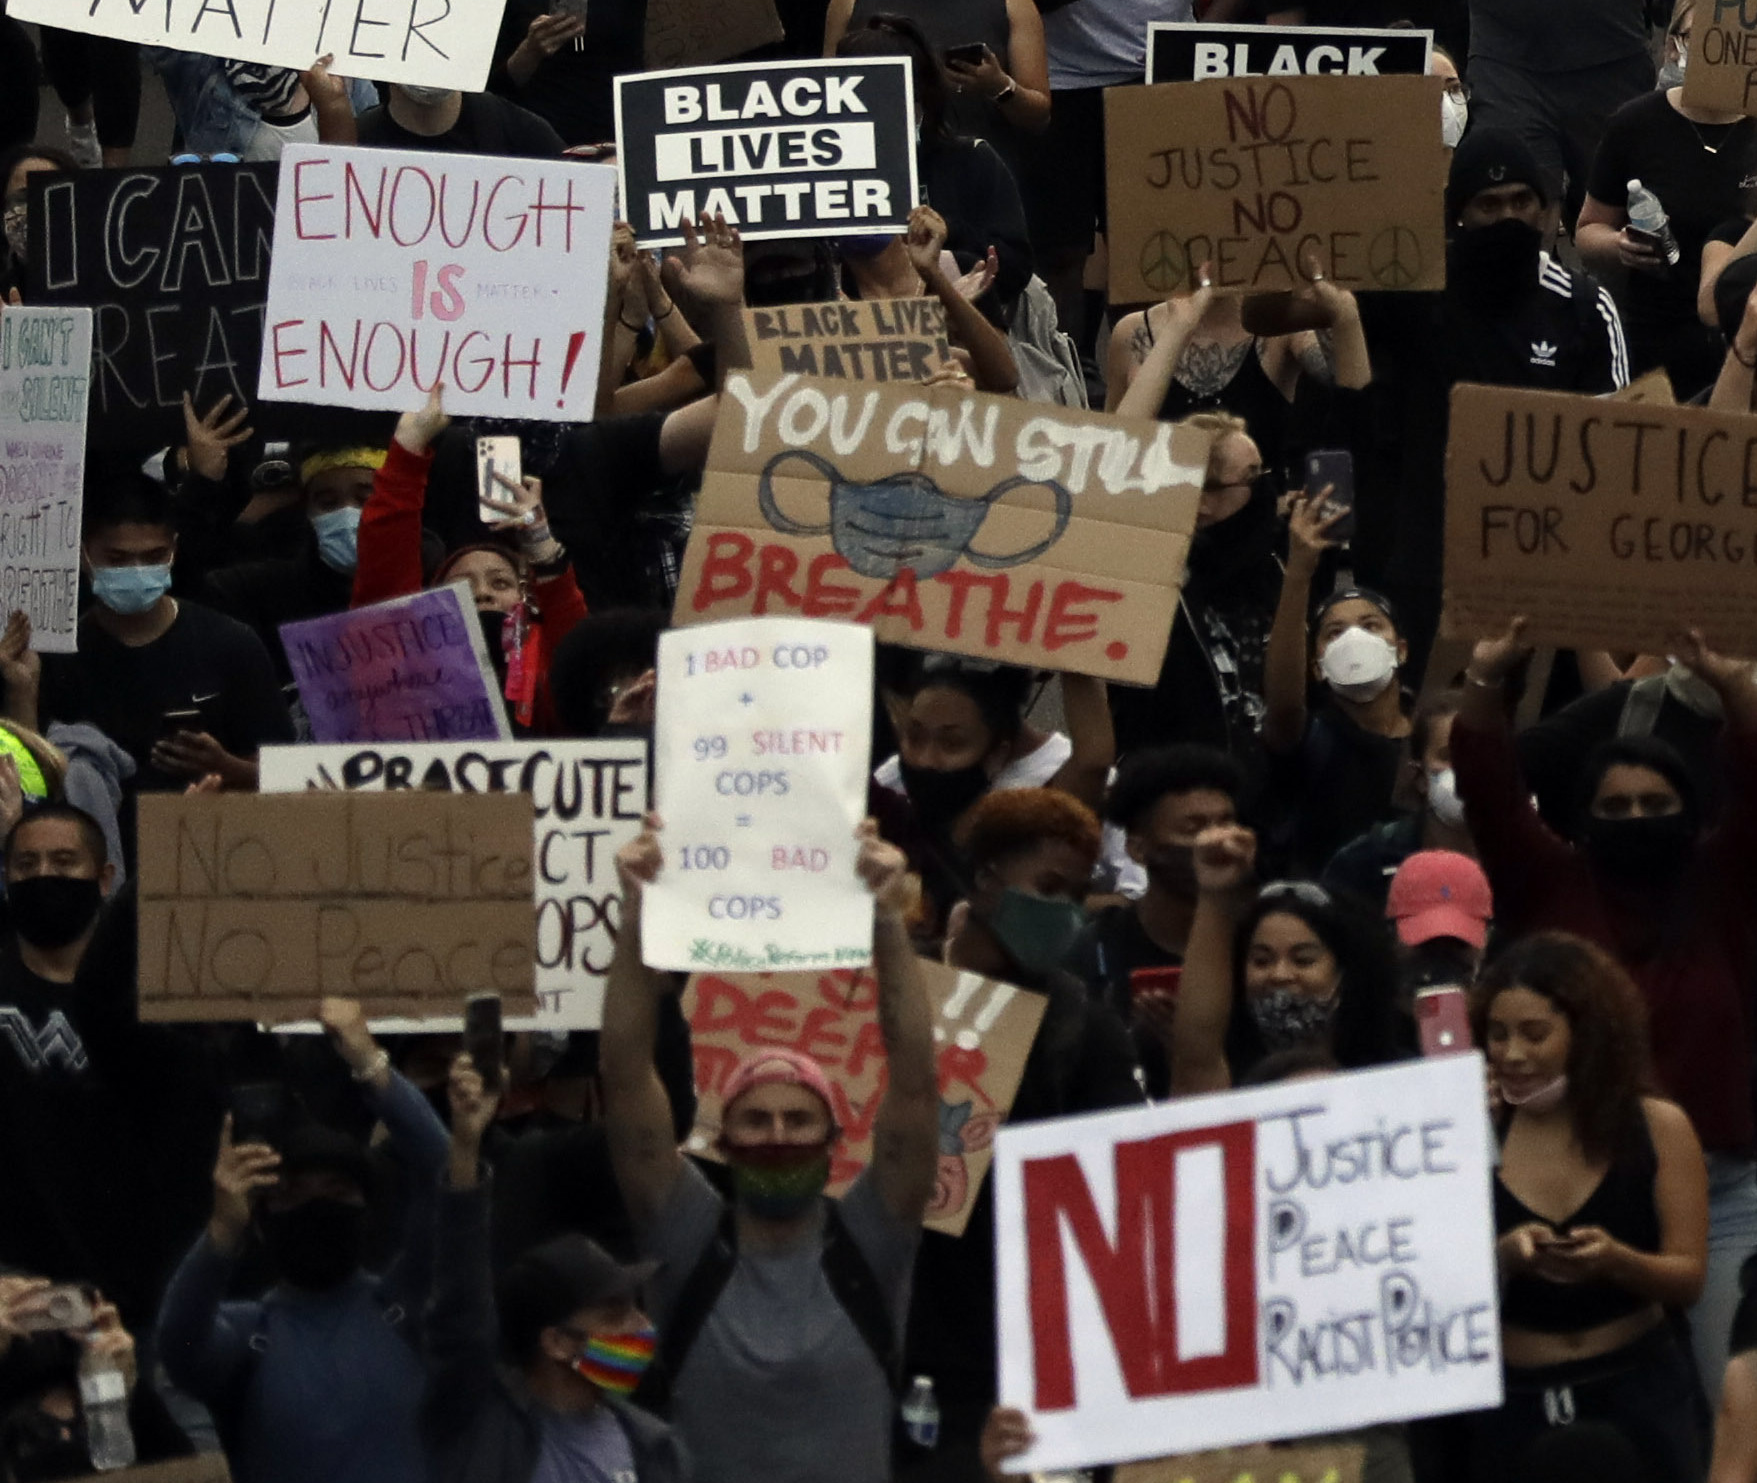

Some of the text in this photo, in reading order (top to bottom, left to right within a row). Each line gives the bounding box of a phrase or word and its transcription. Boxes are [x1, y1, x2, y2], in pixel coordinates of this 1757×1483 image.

[662, 75, 868, 126] BLACK
[1223, 85, 1299, 141] NO
[689, 130, 844, 175] LIVES
[1145, 140, 1379, 192] JUSTICE
[292, 160, 585, 254] ENOUGH
[647, 179, 893, 231] MATTER
[1232, 193, 1301, 236] NO
[1183, 233, 1362, 288] PEACE
[411, 261, 467, 323] IS
[271, 320, 586, 410] ENOUGH!
[1529, 356, 1555, 366] adidas
[1479, 502, 1570, 560] FOR
[694, 531, 1130, 662] BREATHE.
[694, 729, 844, 760] 99 SILENT
[715, 770, 791, 798] COPS
[678, 843, 830, 873] 100 BAD
[1265, 1197, 1420, 1283] PEACE
